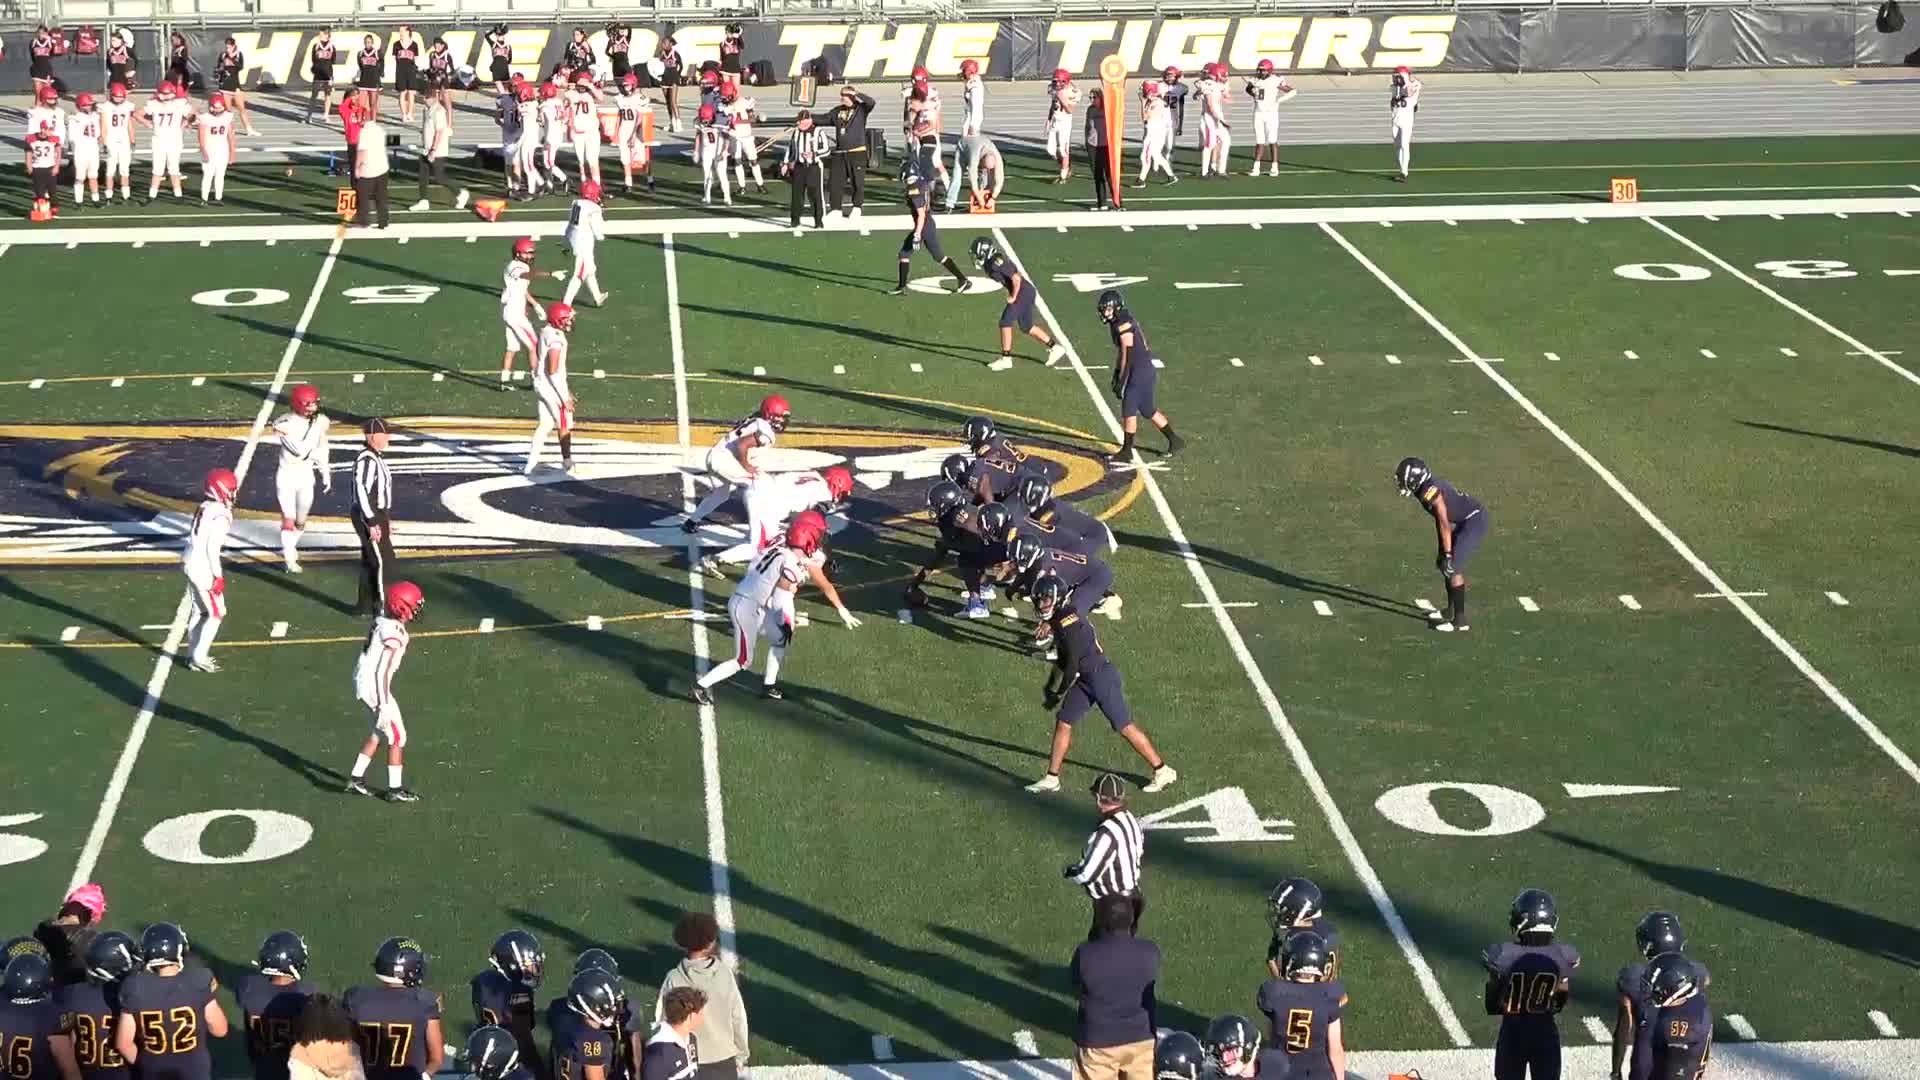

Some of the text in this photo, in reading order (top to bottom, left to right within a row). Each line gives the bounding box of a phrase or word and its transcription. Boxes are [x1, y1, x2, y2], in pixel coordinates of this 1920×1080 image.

[232, 30, 551, 84] HOME
[778, 22, 1000, 78] THE
[1047, 15, 1457, 73] TIGERS
[111, 114, 126, 127] 87
[158, 112, 173, 127] 77
[1615, 182, 1634, 201] 30
[1136, 781, 1547, 843] 40
[1506, 972, 1557, 1014] 10
[140, 1005, 198, 1055] 52
[1287, 1008, 1313, 1054] 5
